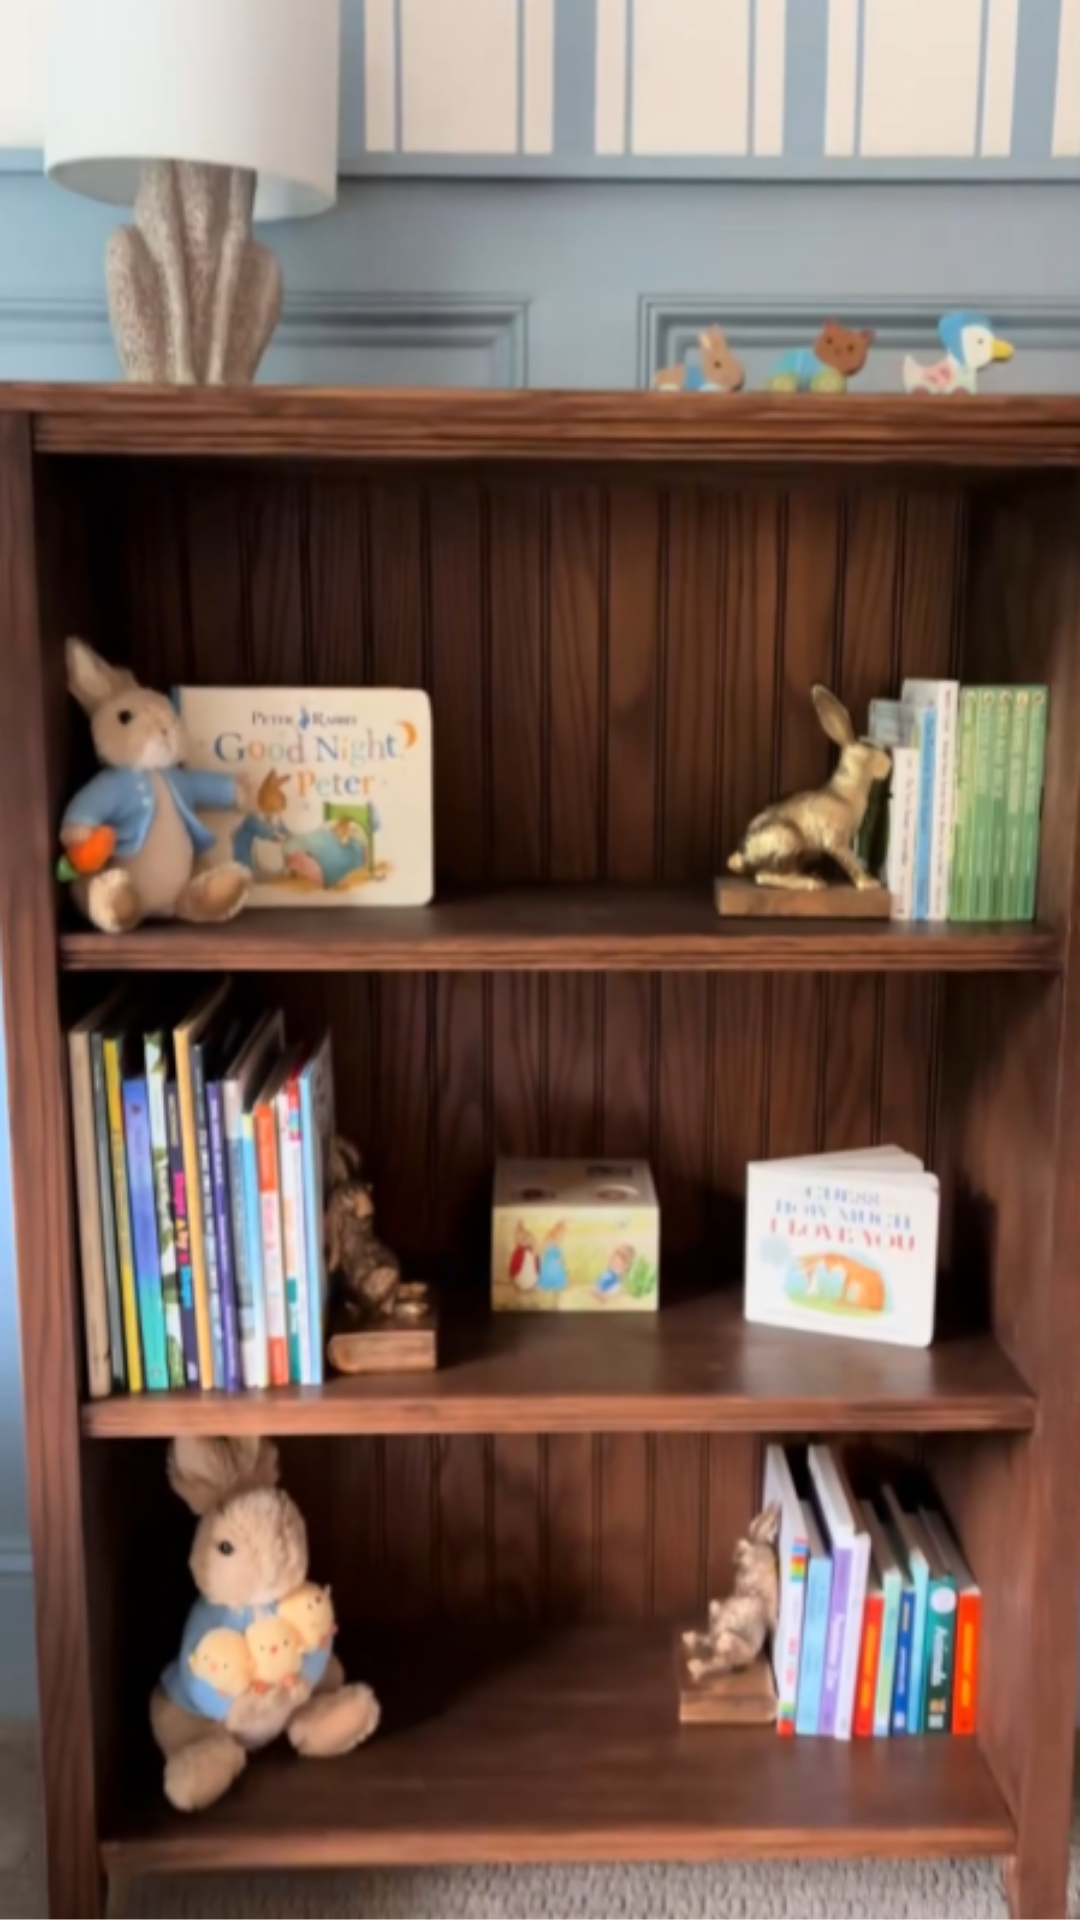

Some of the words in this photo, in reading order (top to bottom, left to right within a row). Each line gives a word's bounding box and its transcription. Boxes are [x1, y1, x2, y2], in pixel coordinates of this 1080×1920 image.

[213, 732, 305, 764] Good
[295, 771, 375, 797] Peter
[775, 1199, 827, 1219] HOW
[839, 1208, 911, 1231] MUCH
[770, 1217, 777, 1235] I
[788, 1219, 854, 1245] LOVE
[863, 1229, 916, 1252] YOU
